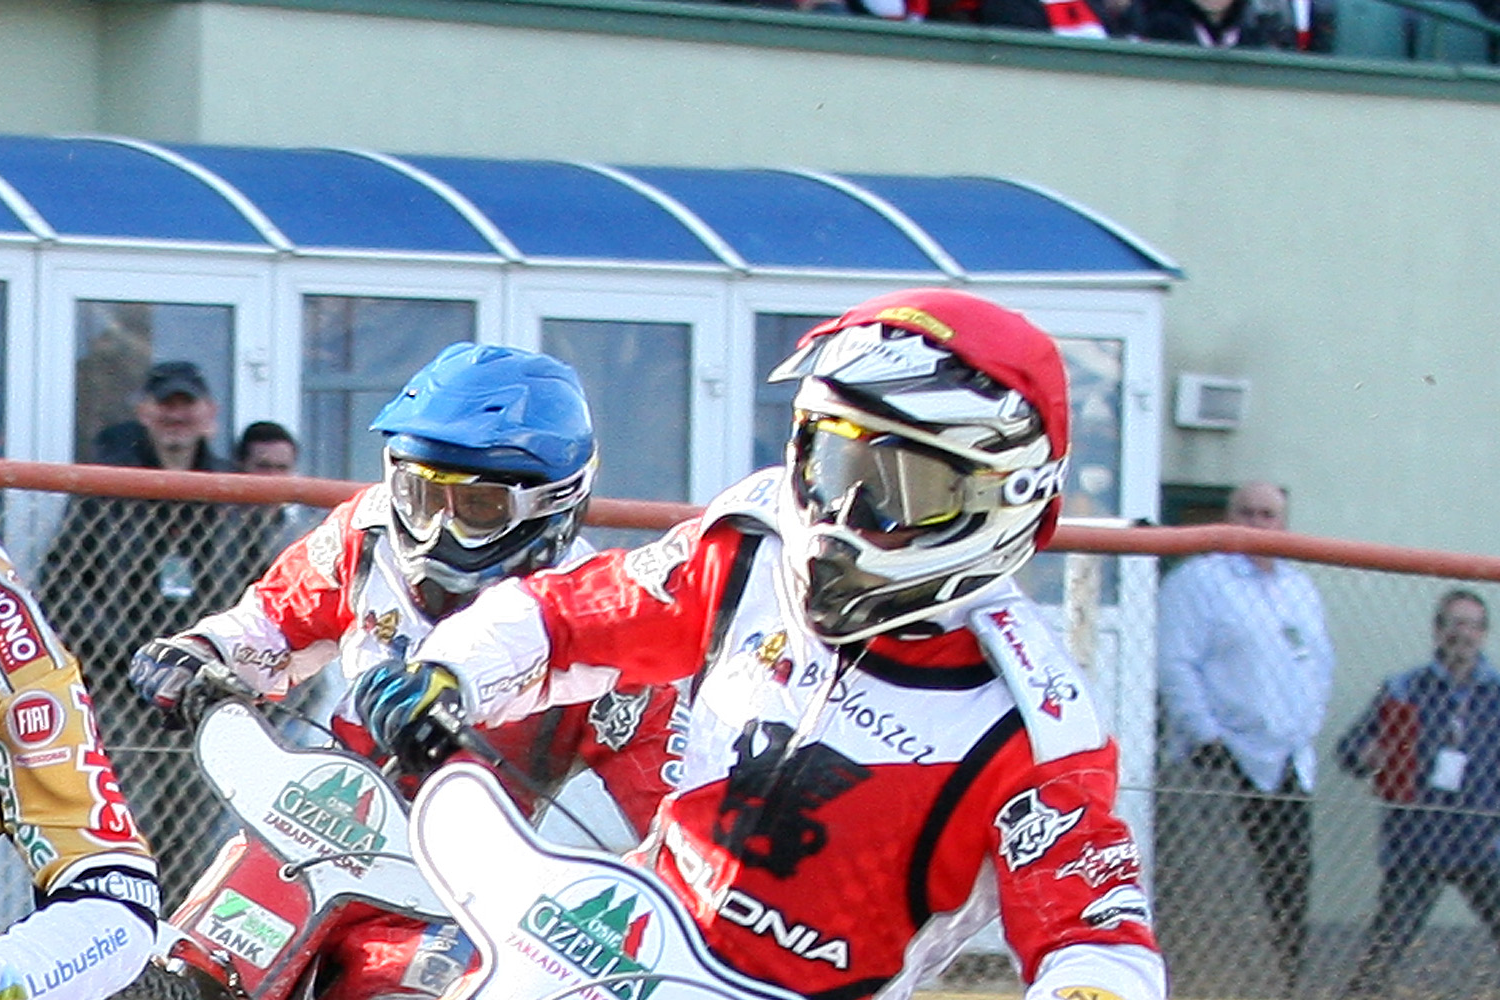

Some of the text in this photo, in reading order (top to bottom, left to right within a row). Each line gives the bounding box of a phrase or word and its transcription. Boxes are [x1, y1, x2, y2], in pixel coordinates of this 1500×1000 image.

[17, 703, 51, 737] FIAT
[797, 660, 936, 765] BDGOSZCZ
[25, 925, 129, 998] Lubuskie
[208, 916, 264, 963] TANK
